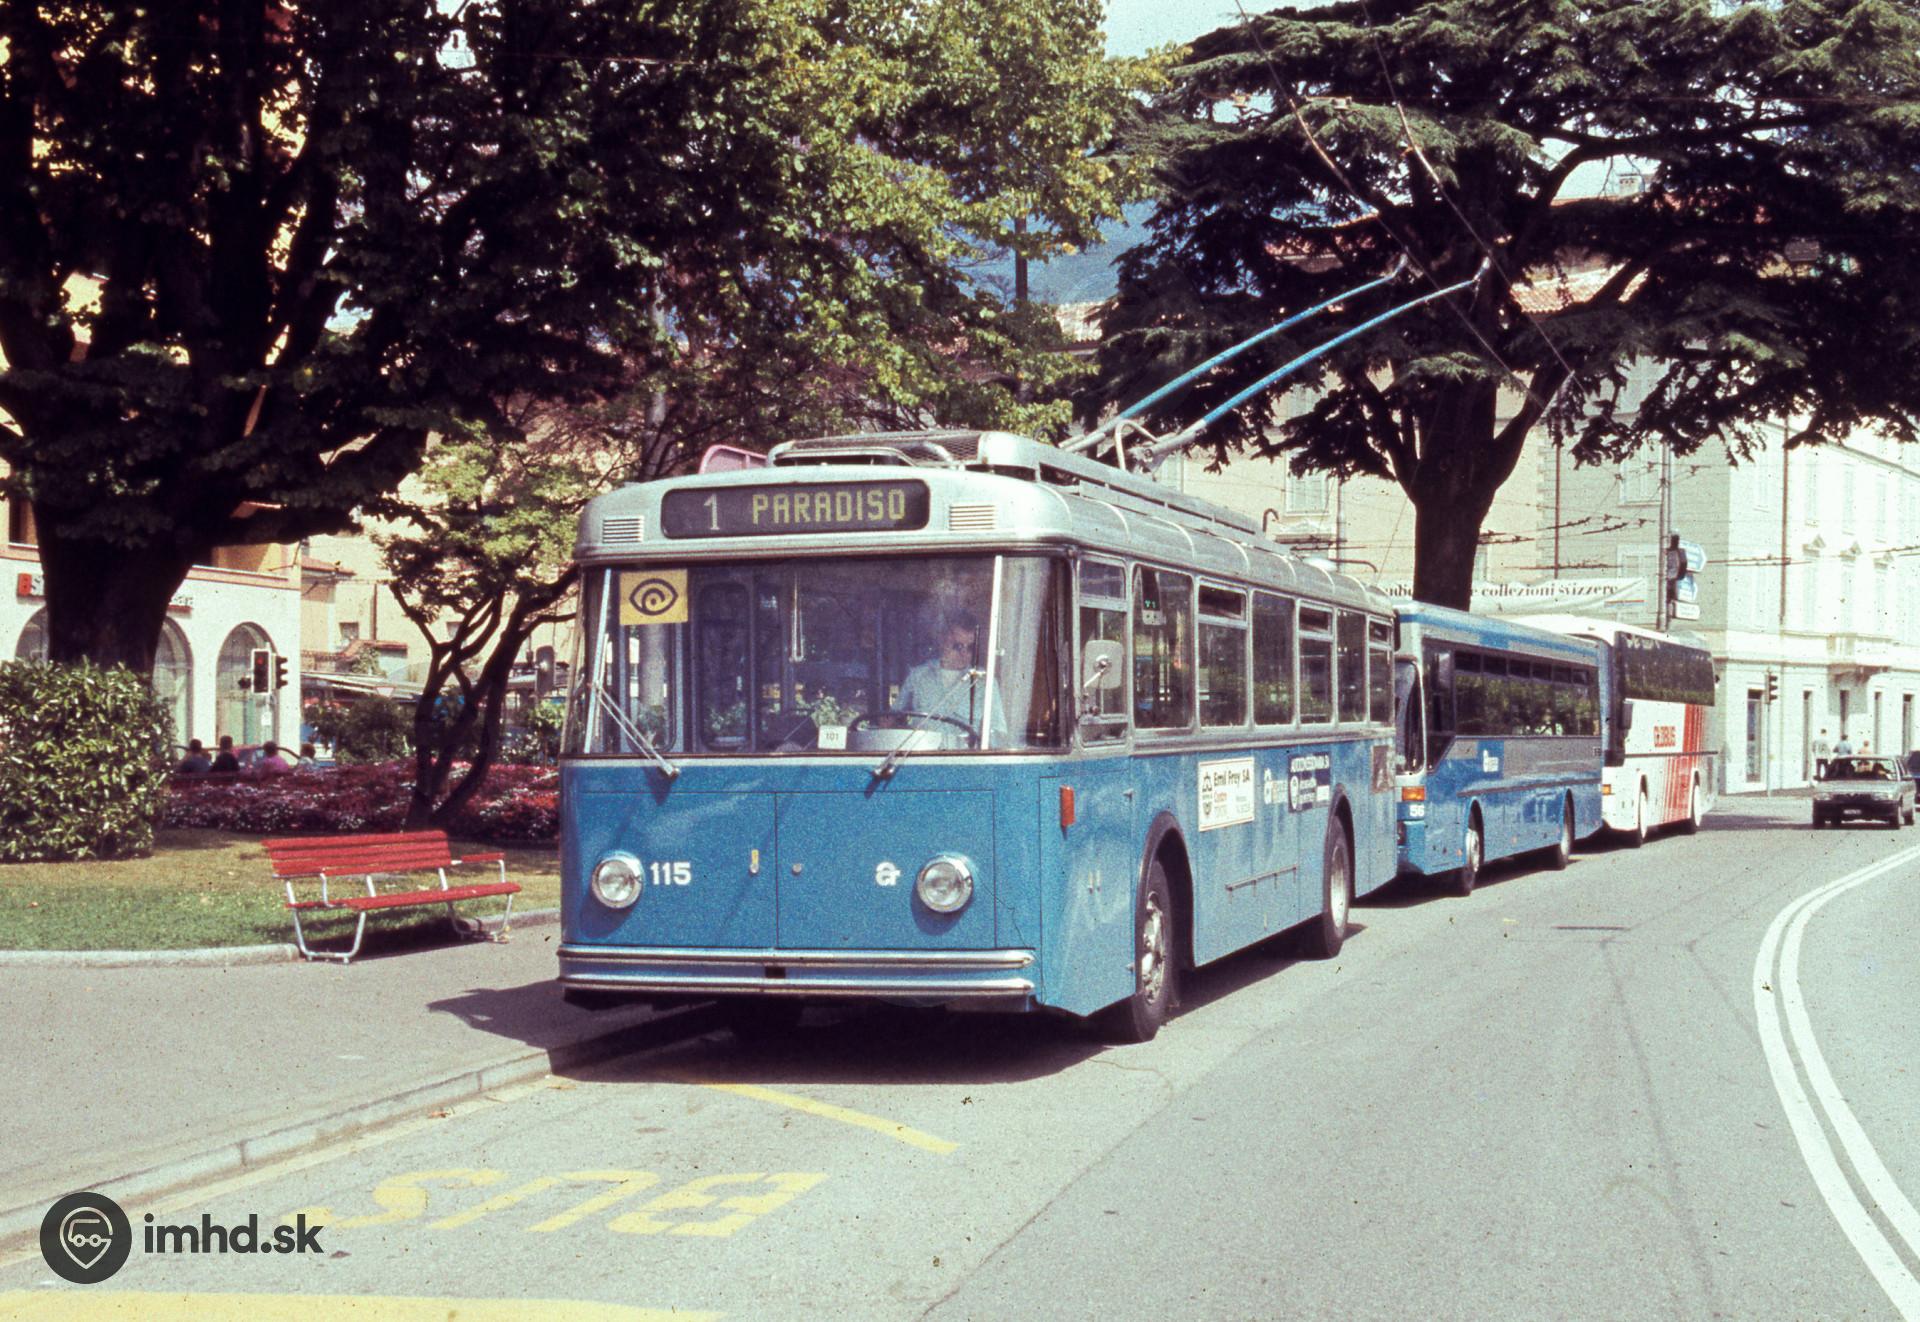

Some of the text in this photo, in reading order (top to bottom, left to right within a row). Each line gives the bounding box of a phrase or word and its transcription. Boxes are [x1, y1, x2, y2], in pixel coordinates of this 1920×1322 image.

[704, 489, 905, 530] 1 PARADISO
[1481, 583, 1555, 597] collezioni
[1558, 582, 1618, 596] svizzere
[650, 861, 692, 886] 115
[280, 1167, 829, 1238] BUS
